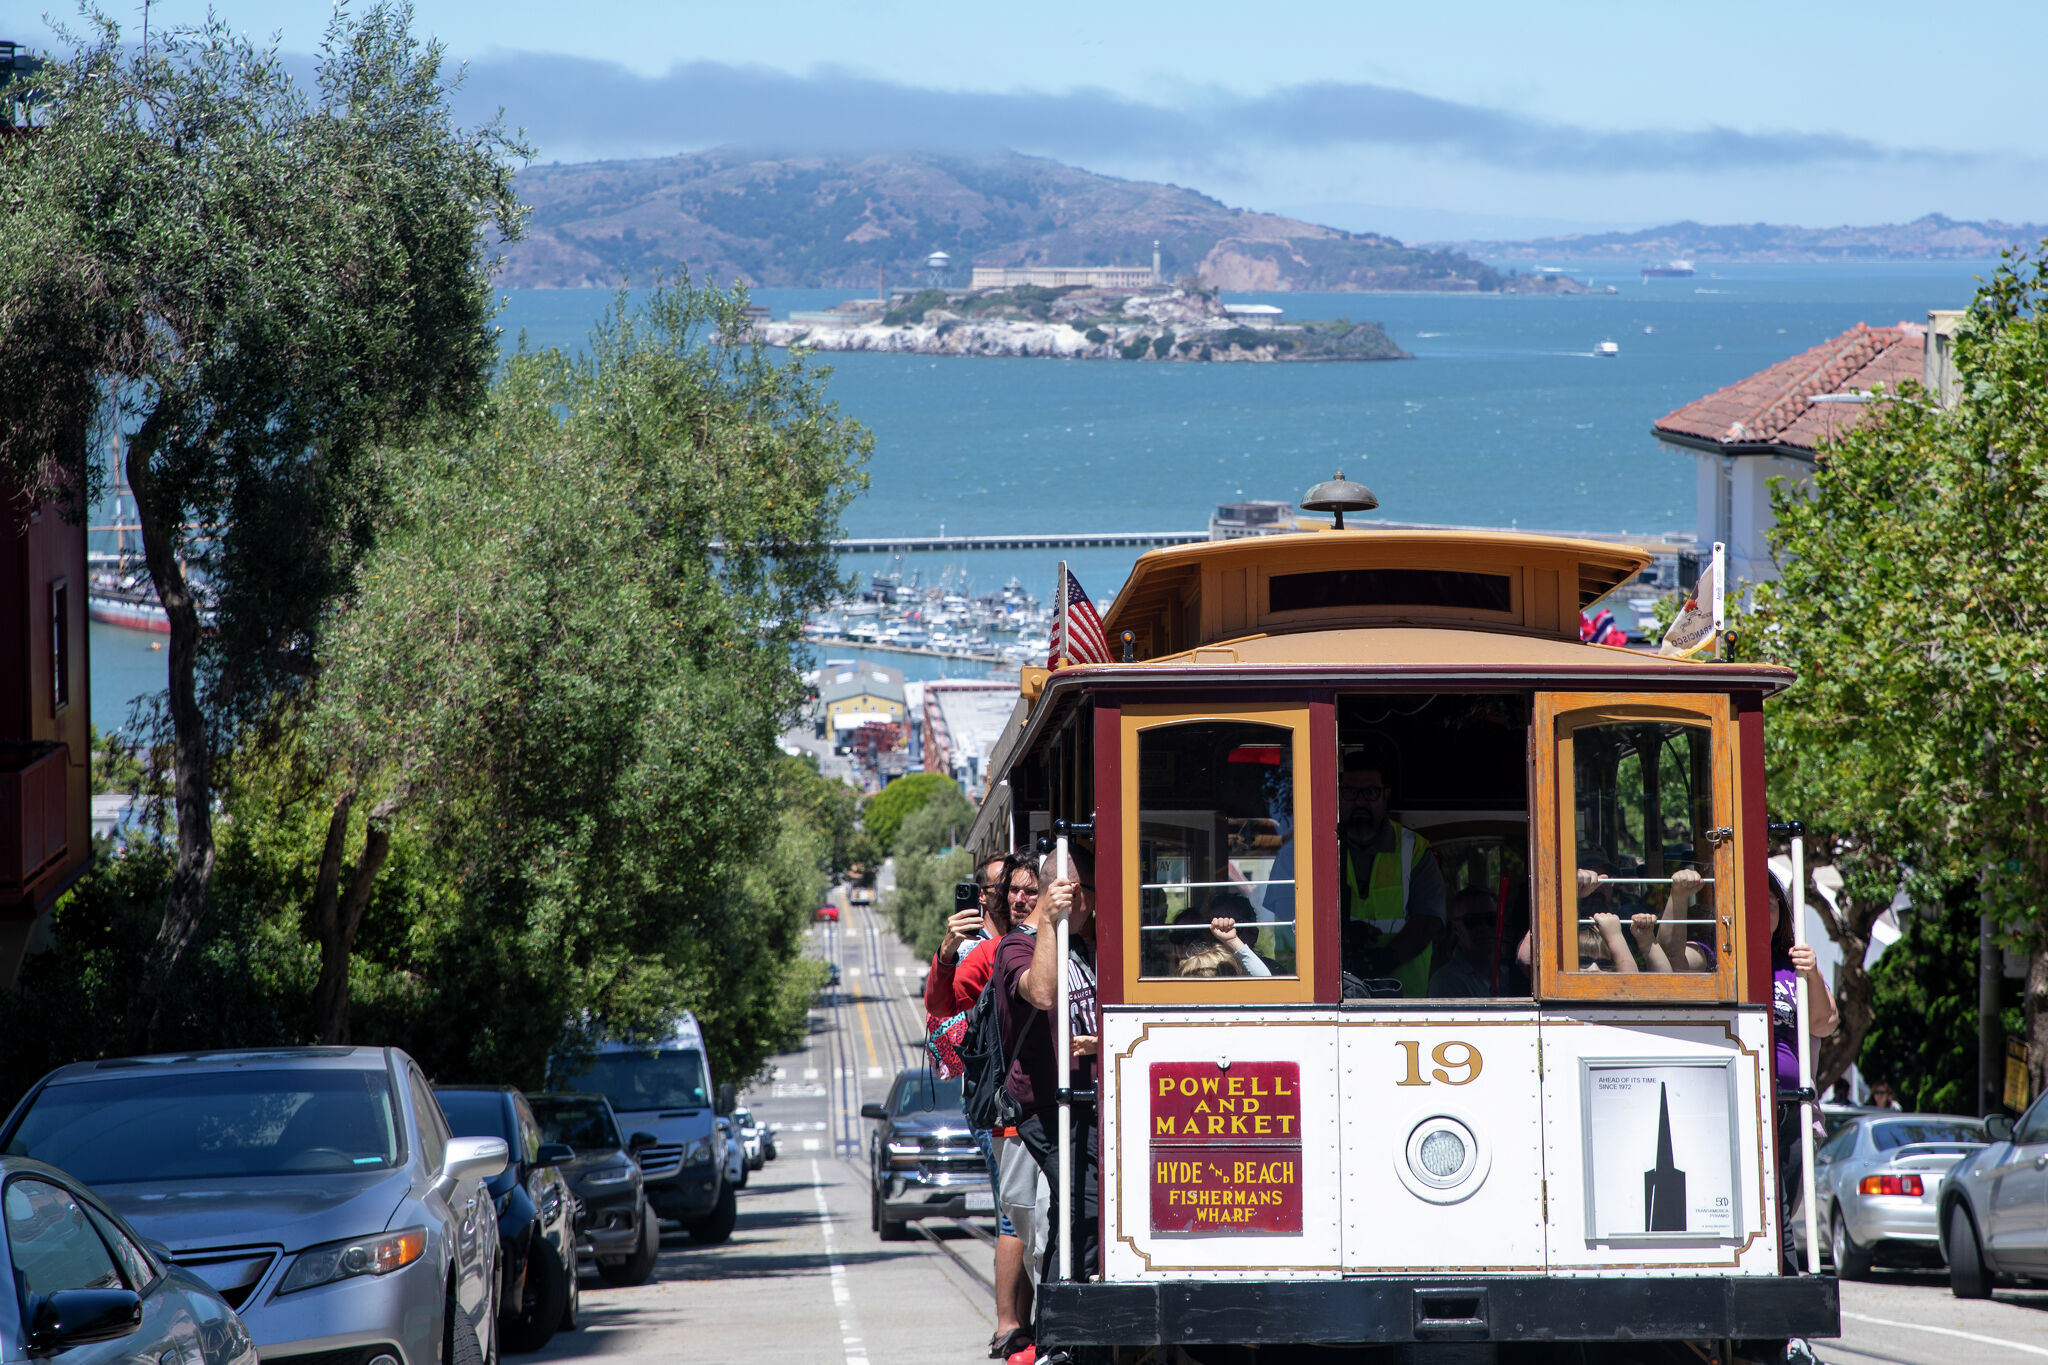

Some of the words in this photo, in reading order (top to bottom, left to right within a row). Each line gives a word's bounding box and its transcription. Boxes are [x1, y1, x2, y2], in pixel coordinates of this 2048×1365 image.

[1395, 1040, 1483, 1086] 19
[1158, 1076, 1292, 1097] POWELL
[1194, 1098, 1260, 1113] AND
[1156, 1115, 1295, 1135] MARKET
[1157, 1161, 1203, 1184] HYDE
[1208, 1162, 1230, 1184] AND
[1234, 1161, 1294, 1184] BEACH
[1169, 1190, 1283, 1206] FISHERMANS
[1196, 1207, 1255, 1223] WHARF
